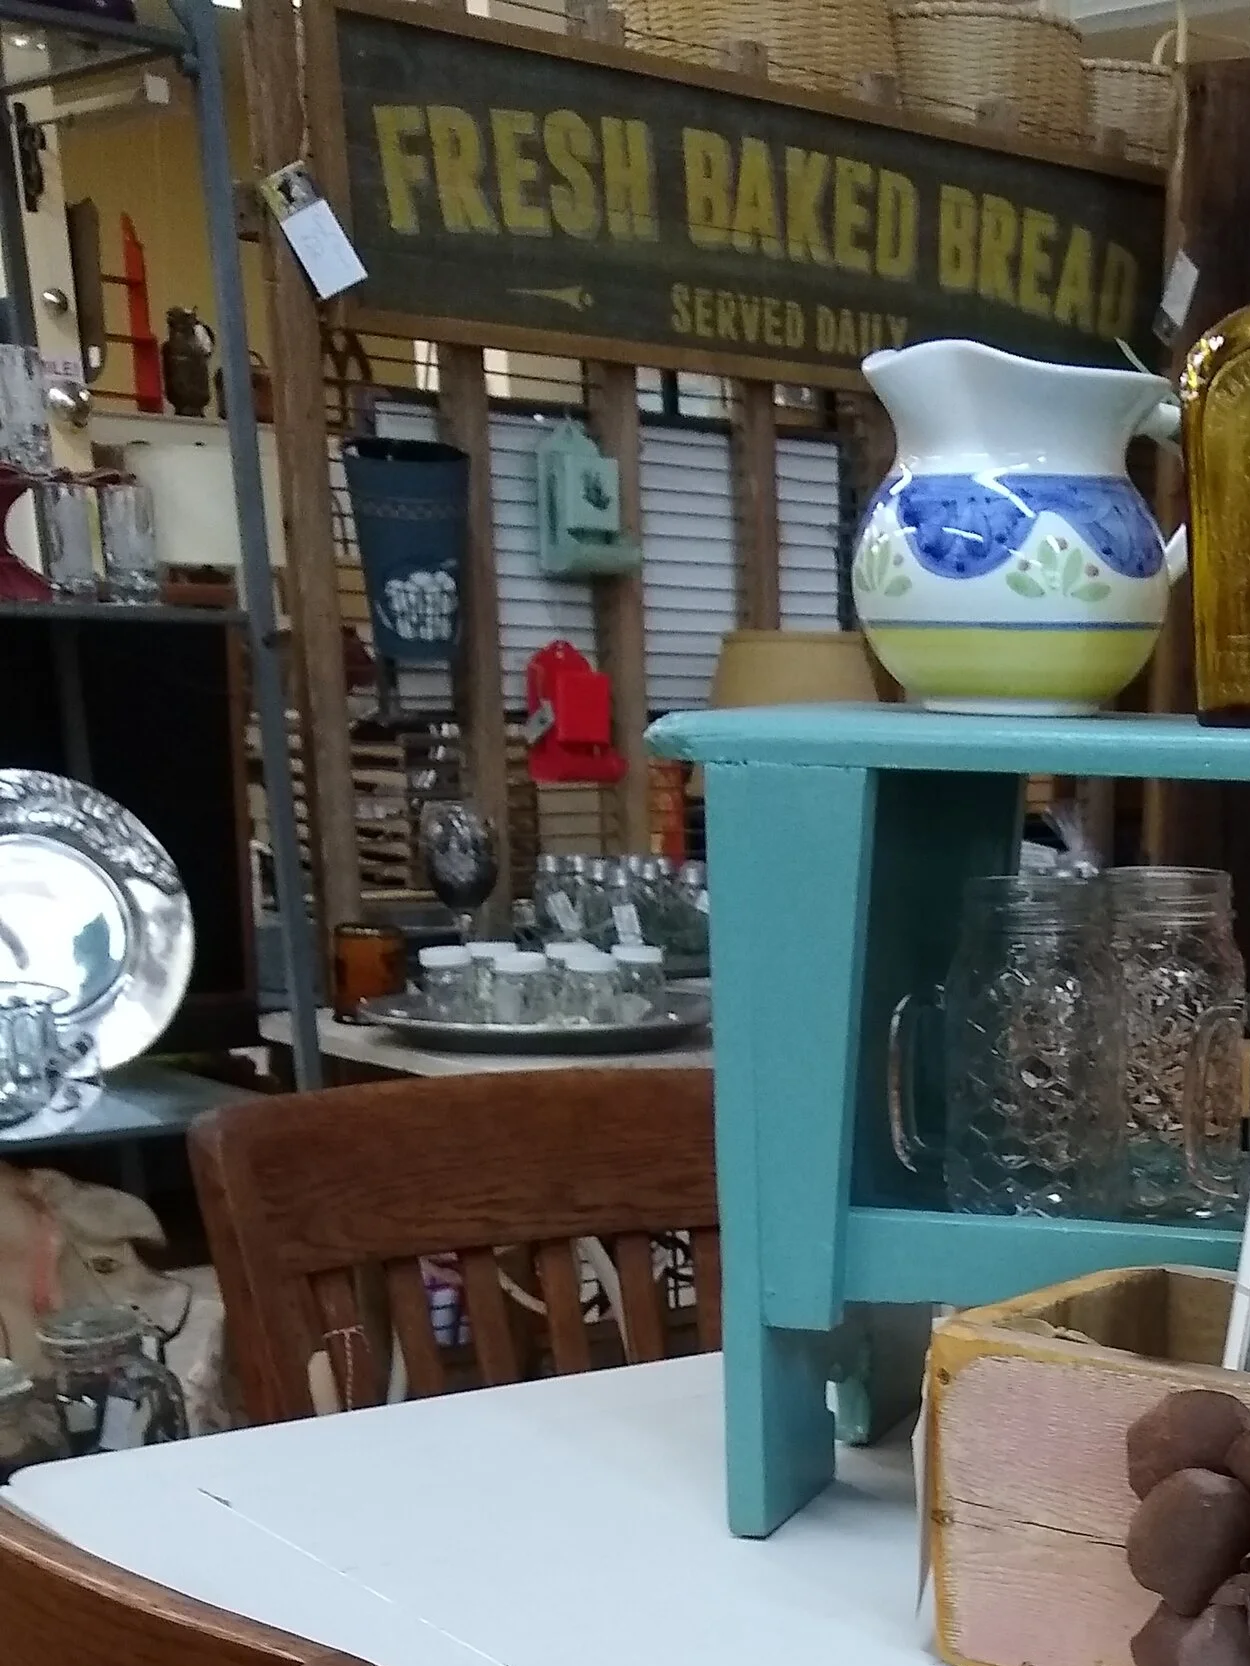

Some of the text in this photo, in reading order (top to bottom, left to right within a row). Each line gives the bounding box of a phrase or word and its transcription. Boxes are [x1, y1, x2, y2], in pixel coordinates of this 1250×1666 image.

[372, 104, 1138, 341] FRESH BAKED BREAD
[671, 282, 805, 349] SERVED
